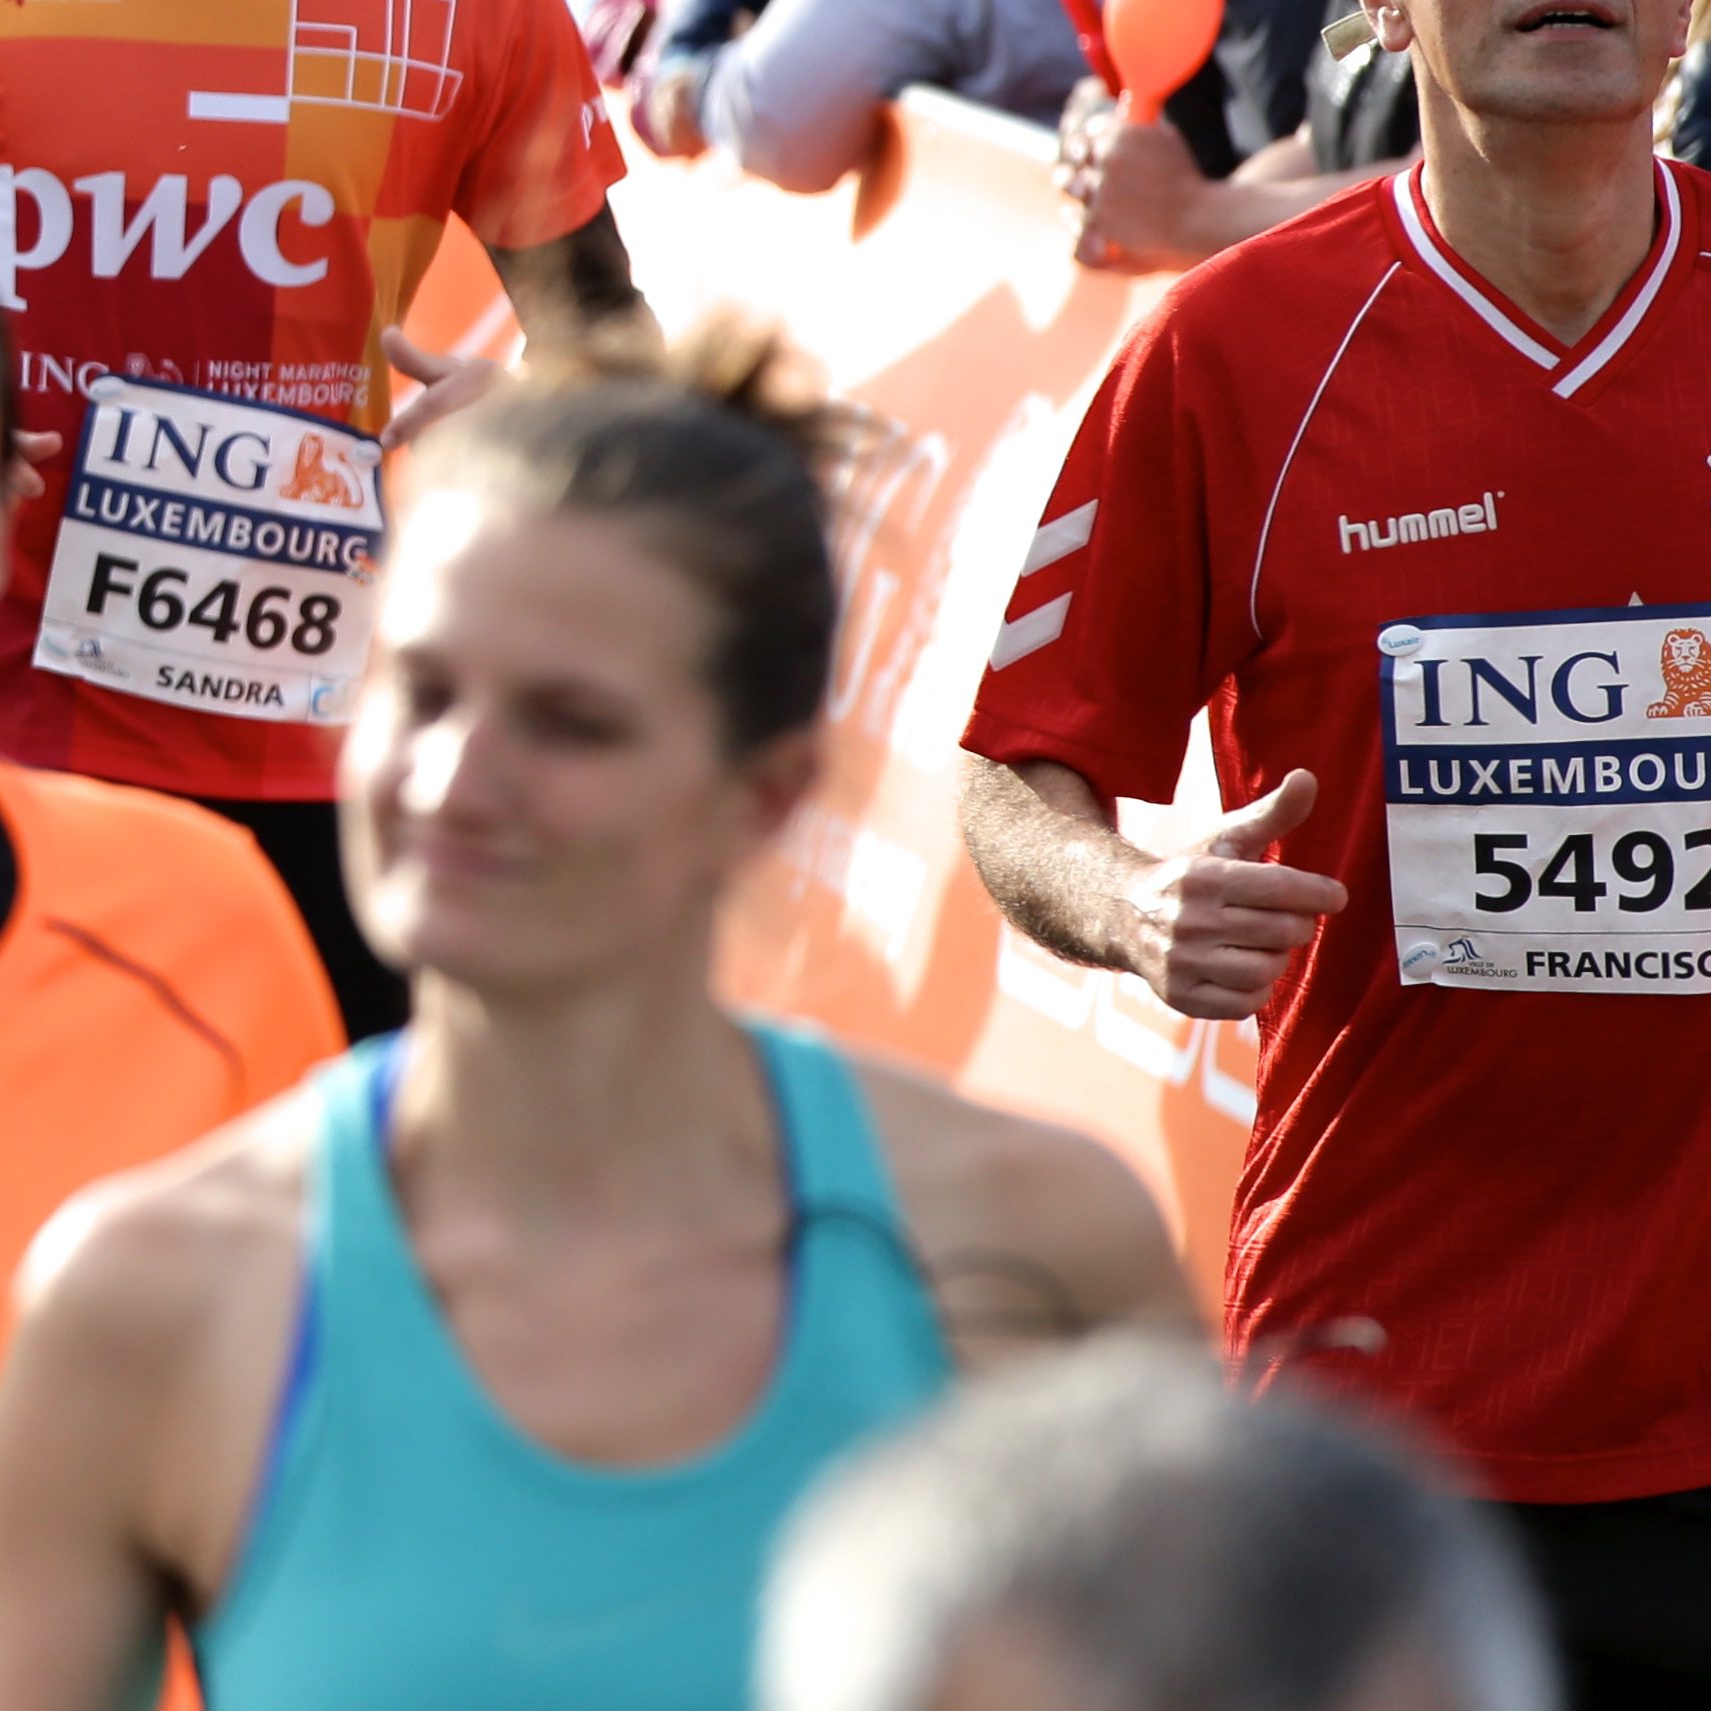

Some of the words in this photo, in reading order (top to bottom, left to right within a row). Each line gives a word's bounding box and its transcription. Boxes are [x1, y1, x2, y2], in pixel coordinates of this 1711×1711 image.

[208, 359, 273, 380] NIGHT
[104, 407, 274, 491] ING
[77, 482, 368, 568] LUXEMBOURG
[1338, 490, 1499, 555] hummel
[84, 551, 343, 657] F6468
[155, 665, 286, 709] SANDRA
[1414, 649, 1630, 728] ING
[1398, 750, 1707, 796] LUXEMBOU
[1473, 828, 1711, 914] 5492
